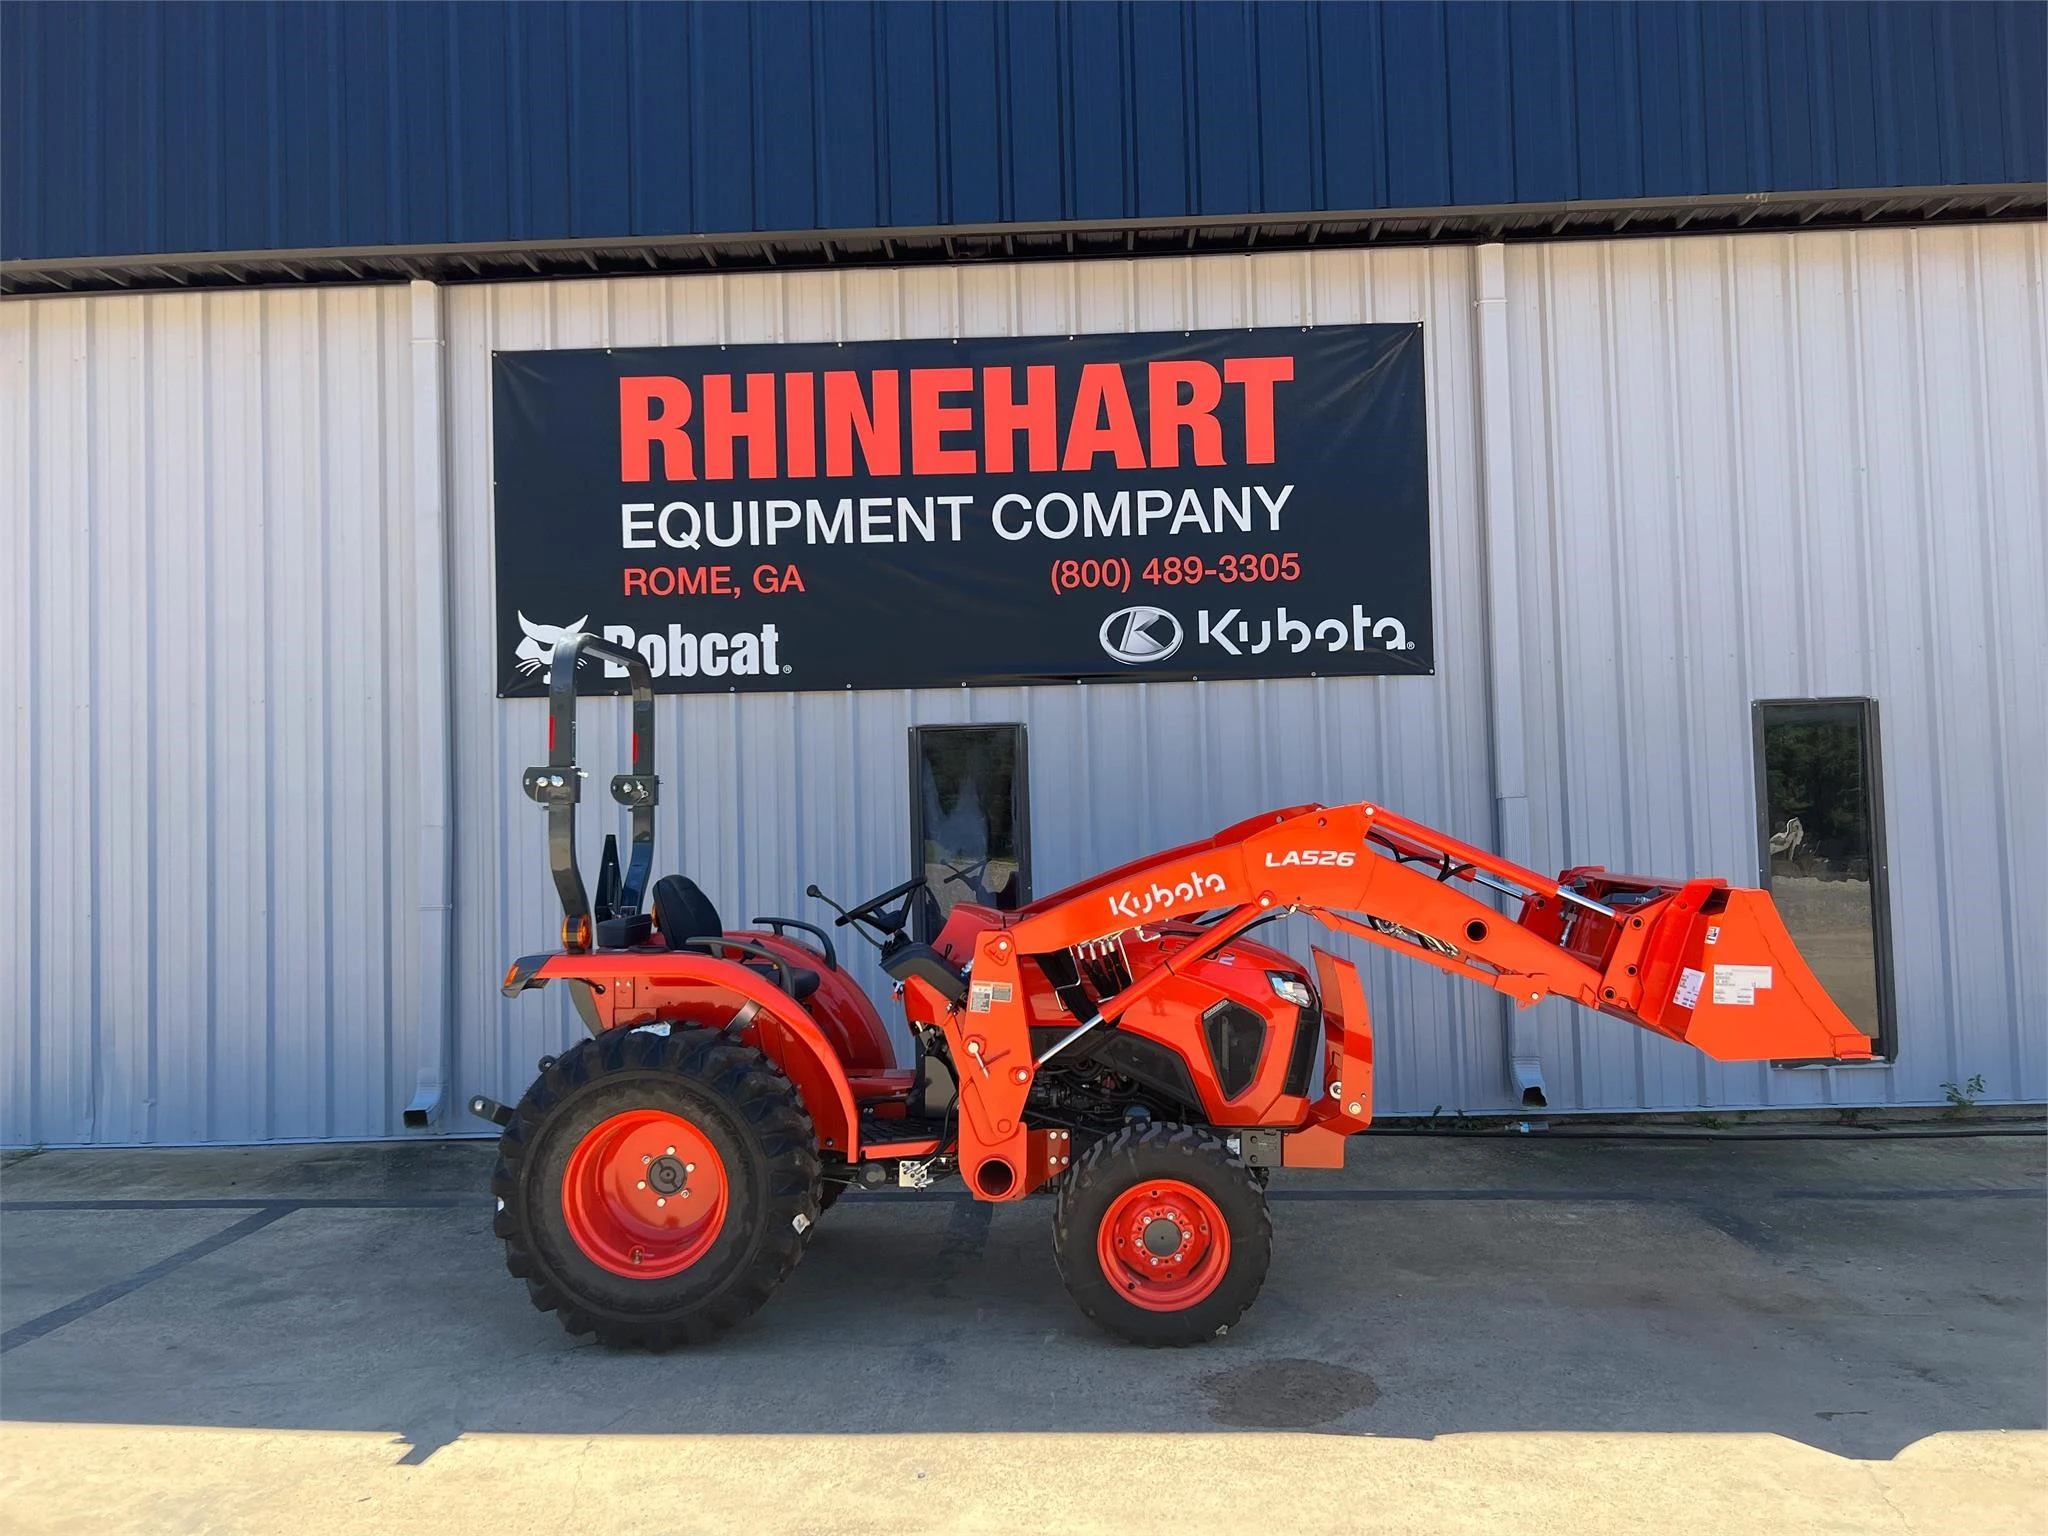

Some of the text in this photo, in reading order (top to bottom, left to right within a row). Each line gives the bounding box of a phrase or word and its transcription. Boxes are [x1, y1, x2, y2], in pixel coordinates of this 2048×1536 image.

[619, 356, 1295, 483] RHINEHART
[621, 484, 1296, 551] EQUIPMENT COMPANY
[623, 564, 806, 599] ROME, GA
[1050, 552, 1301, 595] (800) 489-3305
[1264, 850, 1356, 868] LA526
[1108, 871, 1226, 918] Kubota
